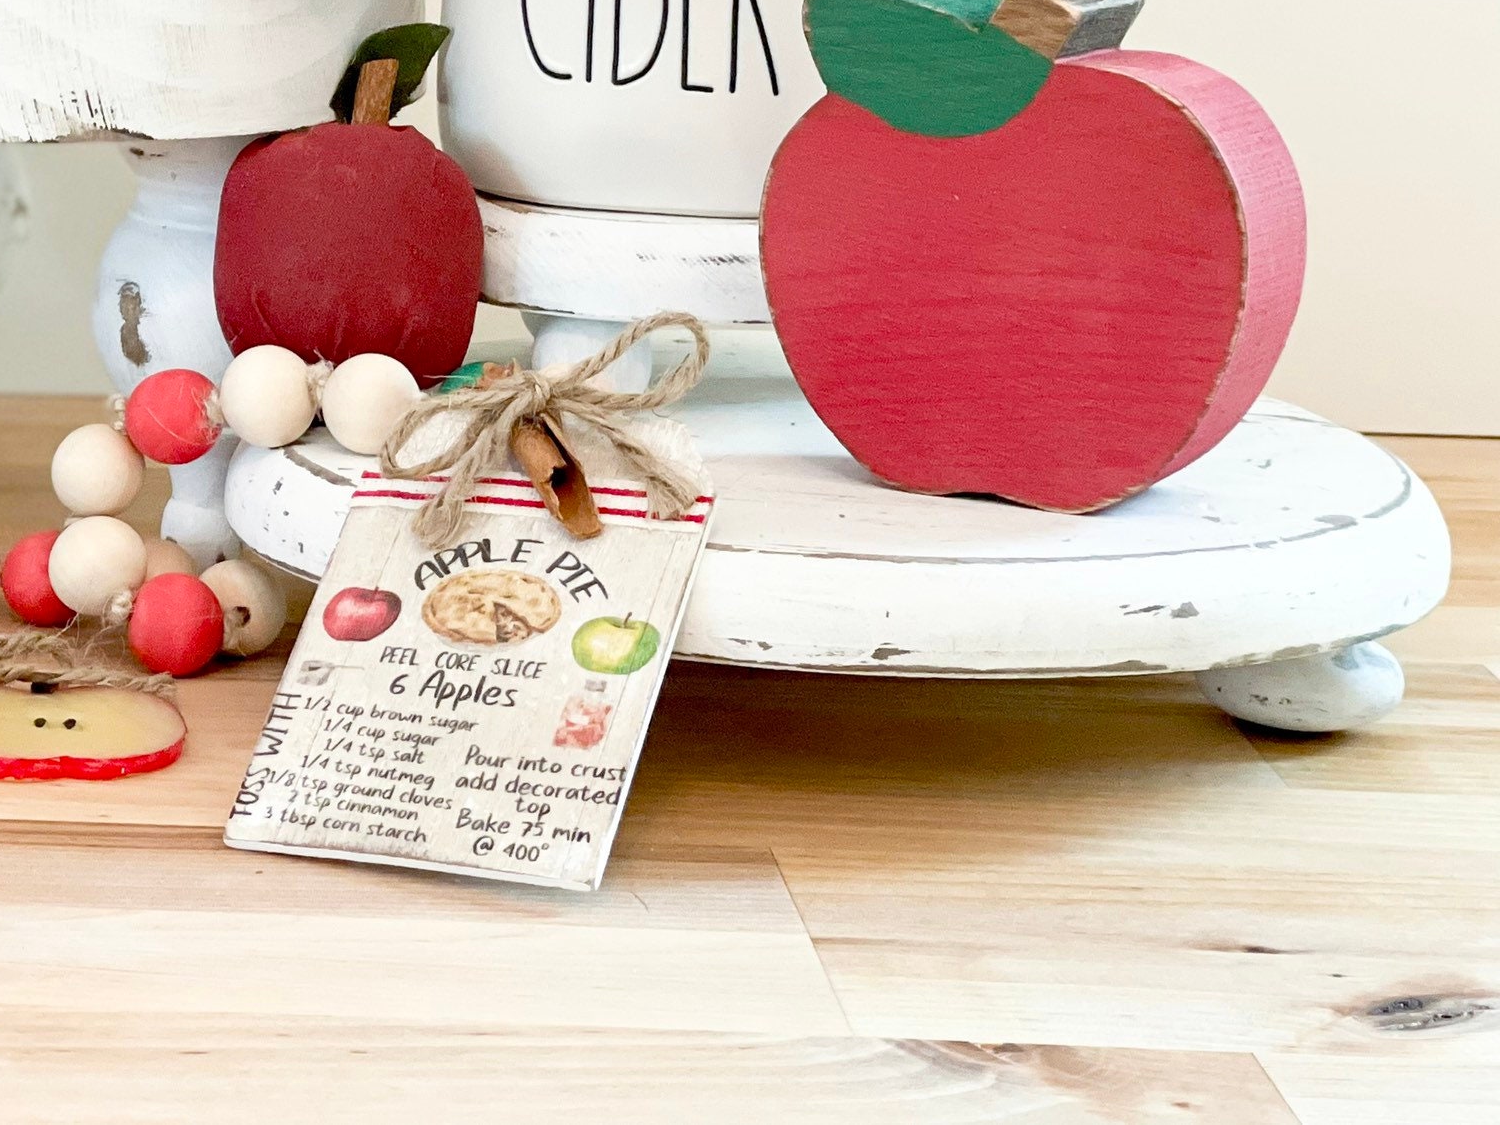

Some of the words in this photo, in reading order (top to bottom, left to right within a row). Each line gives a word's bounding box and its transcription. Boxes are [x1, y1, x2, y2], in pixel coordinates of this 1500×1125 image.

[413, 538, 544, 590] APPLE
[545, 551, 609, 603] PIE
[379, 646, 420, 666] PEEL
[434, 651, 481, 672] CORE
[490, 658, 547, 679] SLICE
[389, 674, 409, 694] 6
[418, 670, 517, 710] Apples
[303, 695, 332, 711] 1/2
[336, 703, 364, 717] cup
[370, 704, 422, 723] brown
[428, 715, 479, 734] sugar
[323, 719, 353, 733] 1/4
[357, 725, 385, 741] cup
[392, 730, 442, 748] sugar
[324, 738, 353, 753] 1/4
[359, 744, 385, 762] tsp
[393, 748, 426, 764] salt
[229, 764, 271, 820] TOSS
[253, 692, 301, 757] WITH
[300, 755, 329, 769] 1/4
[335, 760, 361, 777] tsp
[368, 765, 435, 790] nutmeg
[464, 744, 512, 769] Pour
[517, 756, 562, 774] into
[571, 763, 627, 782] crust
[267, 770, 296, 786] 1/8
[301, 775, 328, 791] tsp
[333, 782, 395, 802] ground
[399, 787, 453, 810] cloves
[288, 790, 298, 802] 2
[304, 794, 331, 812] tsp
[337, 798, 419, 821] cinnamon
[455, 772, 499, 791] add
[505, 776, 622, 805] decorated
[265, 807, 273, 819] 3
[280, 808, 317, 827] tbsp
[322, 817, 360, 833] corn
[366, 824, 426, 843] starch
[455, 808, 510, 834] Bake
[521, 821, 545, 837] 75
[552, 826, 591, 843] min
[515, 797, 551, 821] top
[473, 835, 495, 856] @
